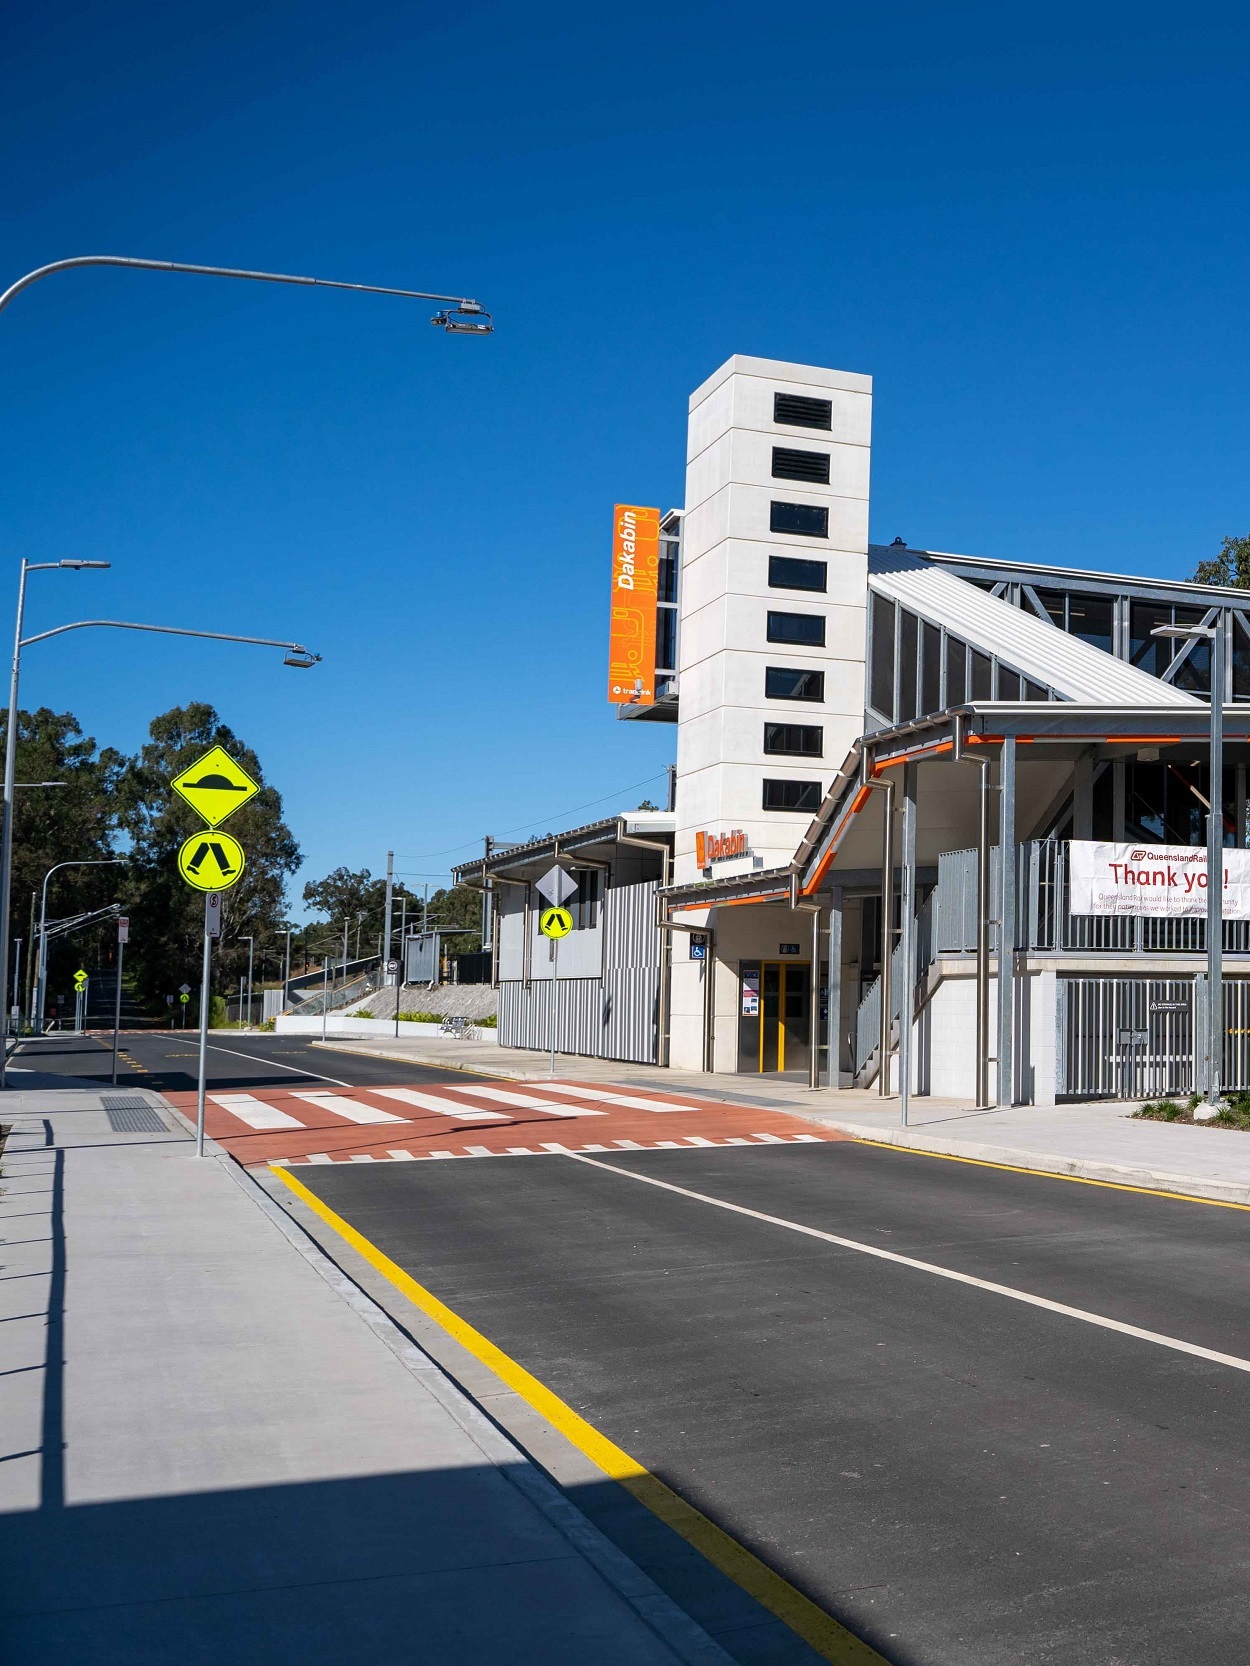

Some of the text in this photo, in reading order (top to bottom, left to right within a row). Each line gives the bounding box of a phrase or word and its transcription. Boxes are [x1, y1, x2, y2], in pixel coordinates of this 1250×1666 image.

[618, 511, 637, 590] Dakabin
[622, 687, 652, 696] tranink
[708, 829, 745, 859] Dakabin
[1109, 863, 1229, 893] Thank yo!
